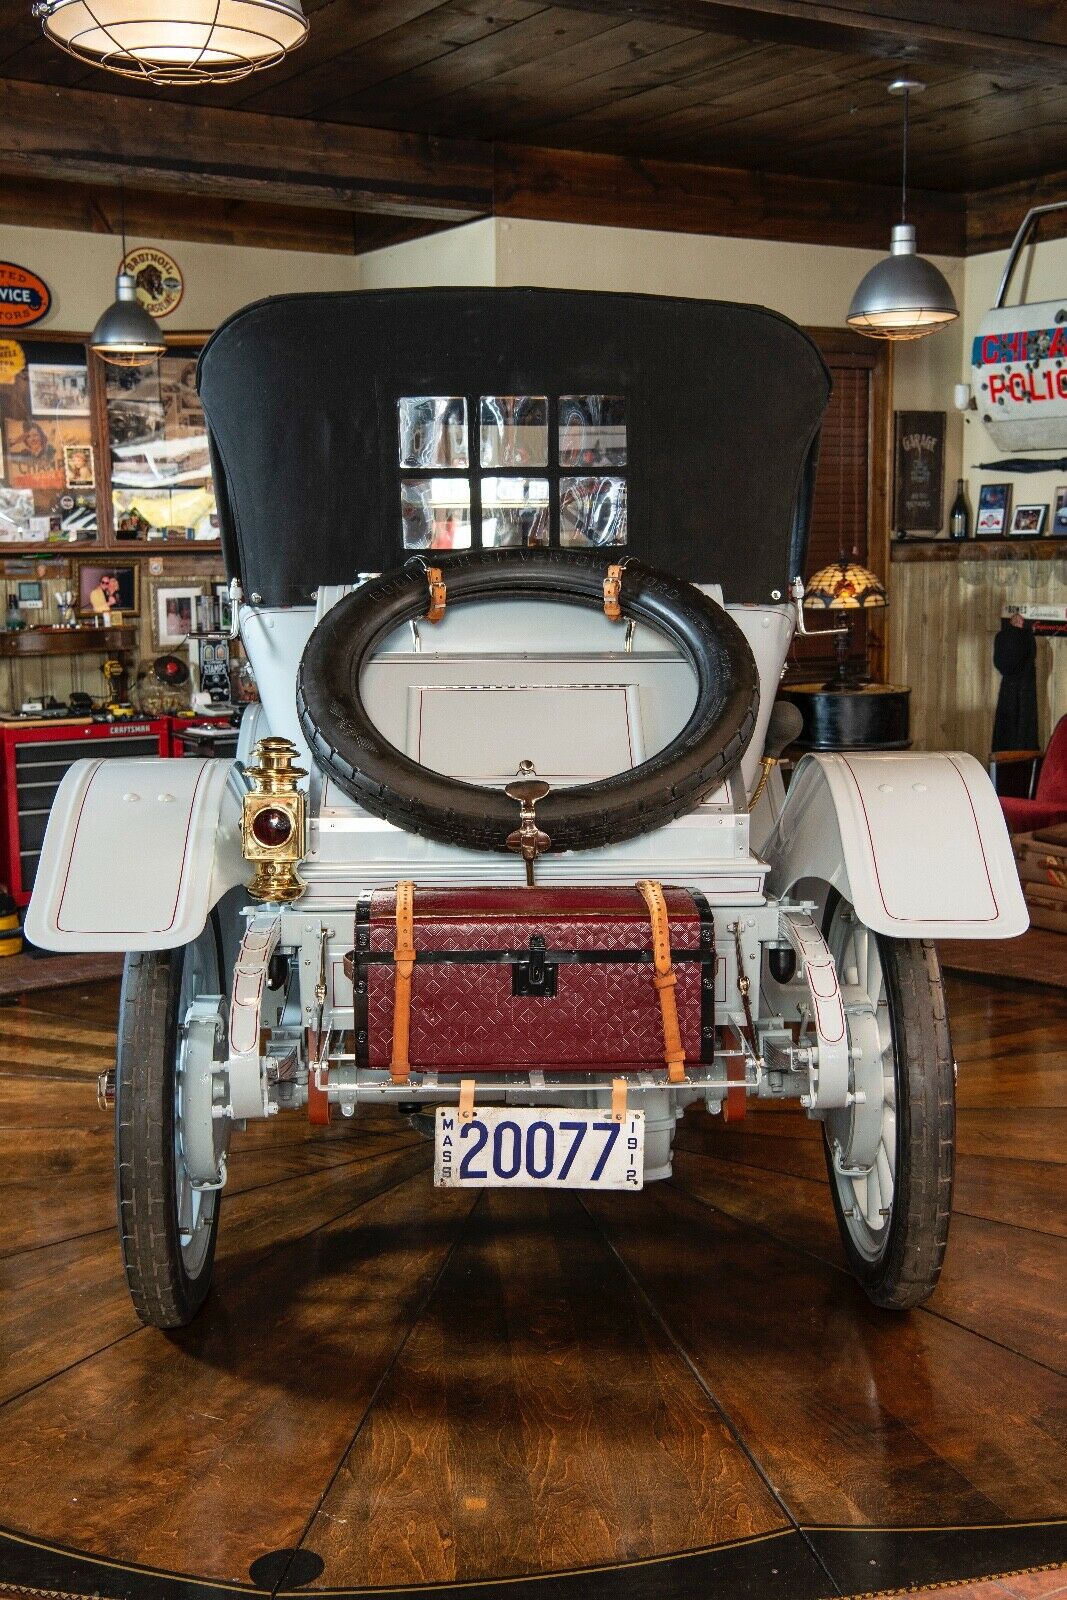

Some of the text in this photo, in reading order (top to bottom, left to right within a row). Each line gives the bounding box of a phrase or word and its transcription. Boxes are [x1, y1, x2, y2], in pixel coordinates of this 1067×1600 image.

[110, 725, 150, 734] CRAFTSMAN
[442, 1118, 454, 1178] MASS
[459, 1120, 621, 1181] 20077
[626, 1121, 638, 1182] 1912
